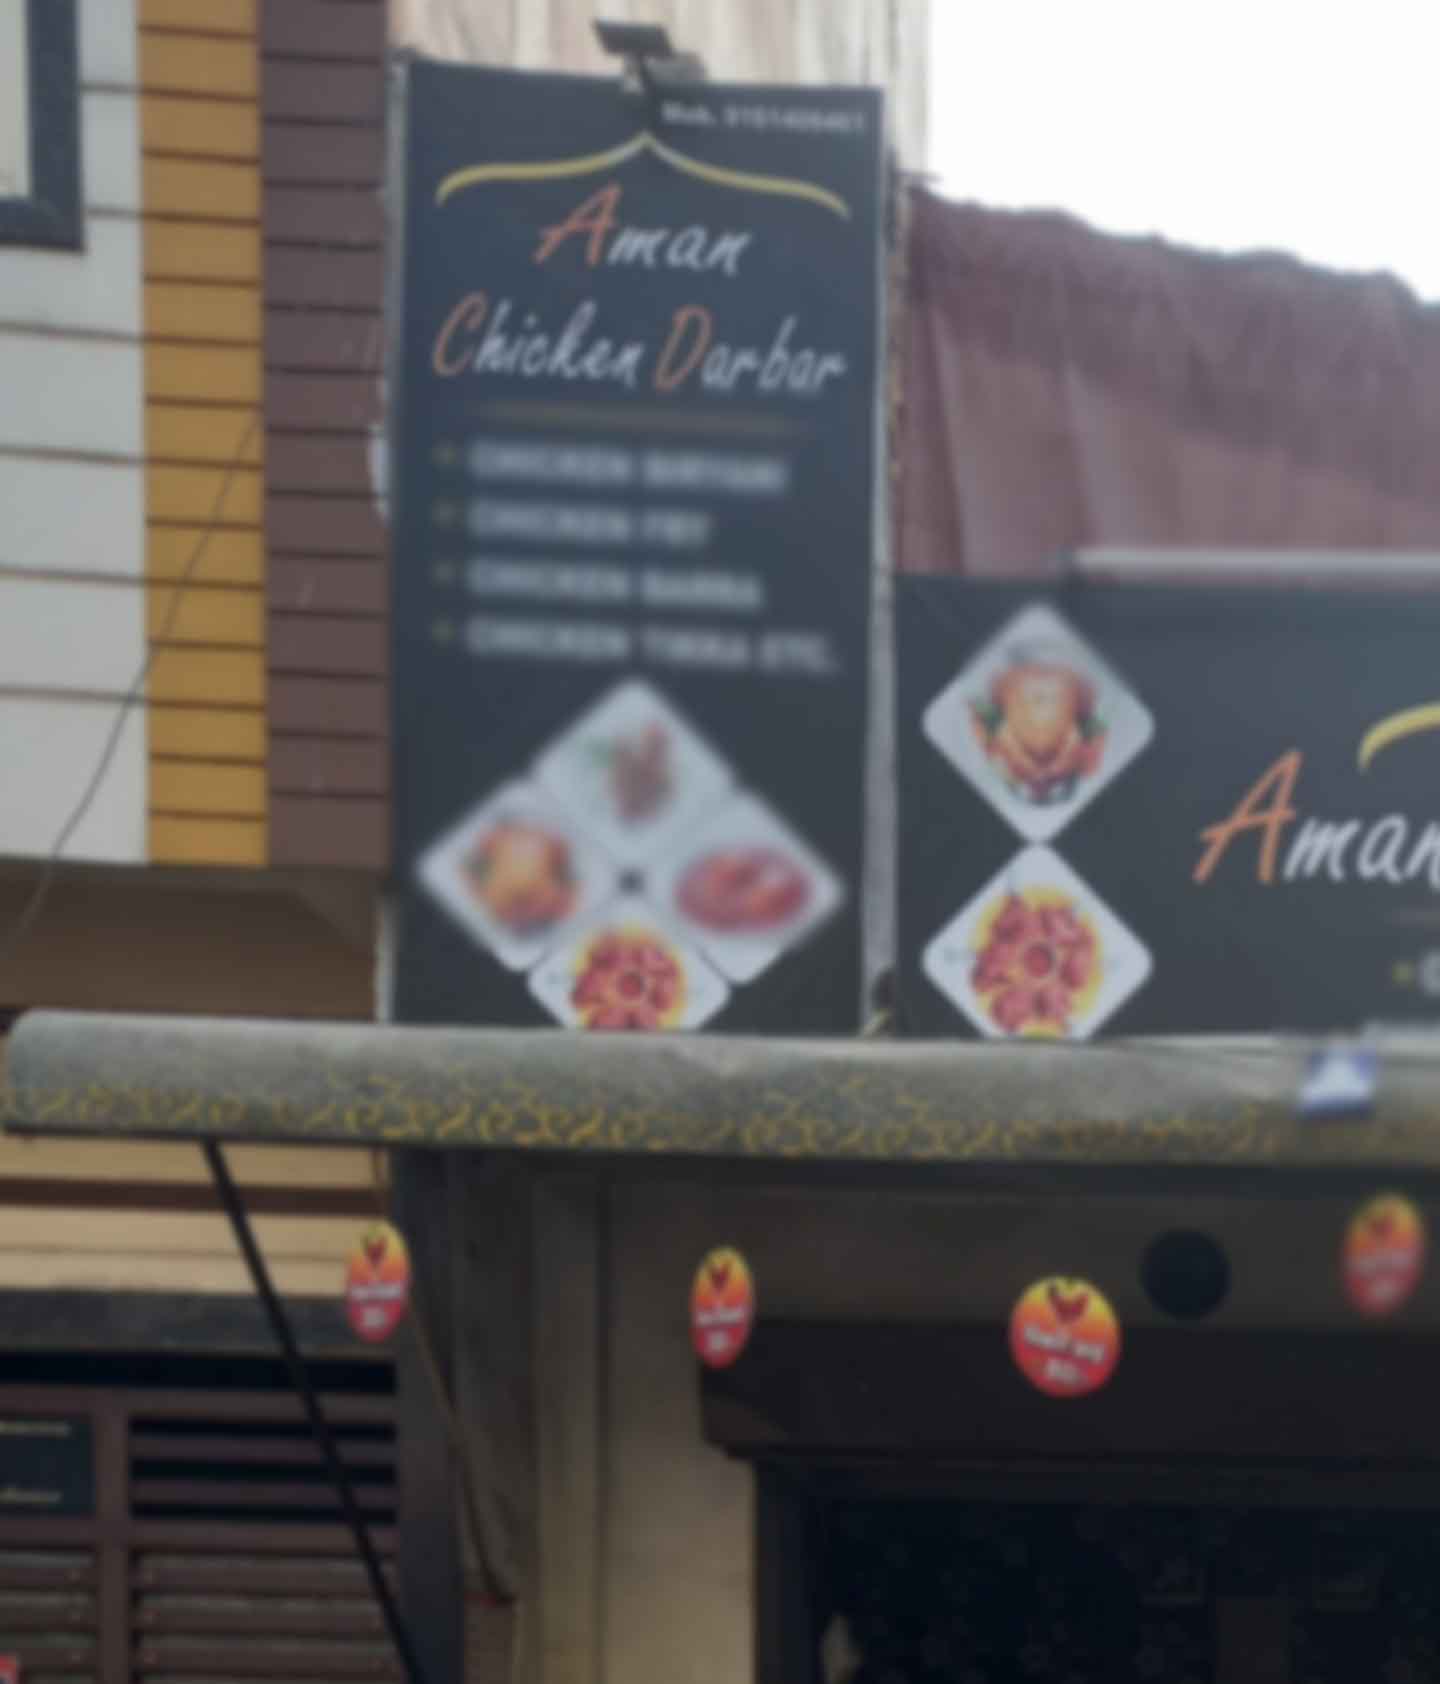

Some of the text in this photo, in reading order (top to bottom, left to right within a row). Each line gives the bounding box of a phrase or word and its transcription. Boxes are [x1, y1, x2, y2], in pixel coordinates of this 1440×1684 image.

[533, 184, 752, 275] Aman
[433, 291, 847, 392] Chicken Darbar
[469, 442, 630, 484] CHICKEN
[469, 500, 630, 543] CHICKEN
[468, 558, 629, 600] CHICKEN
[468, 616, 629, 658] CHICKEN
